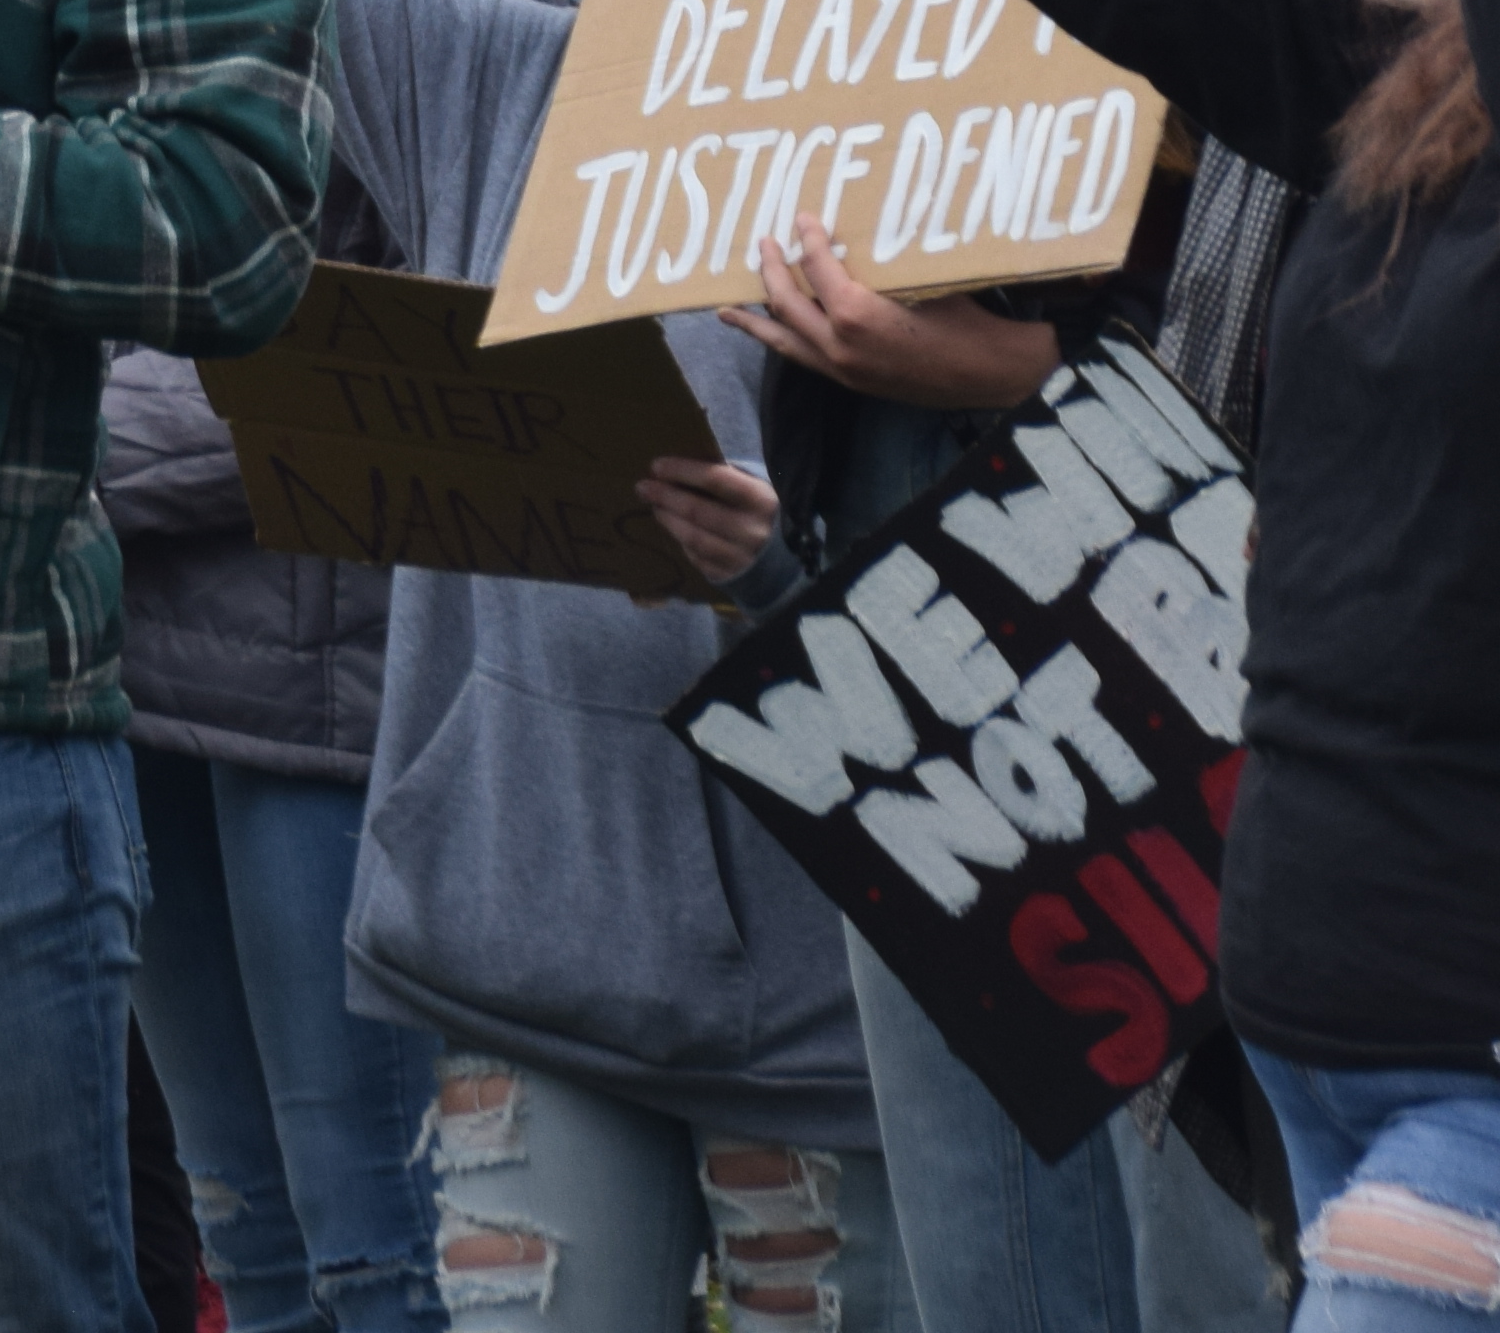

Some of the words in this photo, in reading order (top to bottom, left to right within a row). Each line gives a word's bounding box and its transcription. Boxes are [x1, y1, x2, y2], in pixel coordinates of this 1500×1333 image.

[535, 124, 884, 313] JUSTICE
[872, 88, 1135, 263] DENIED
[280, 284, 470, 372] AY
[313, 365, 598, 461] THEIR
[269, 453, 686, 593] NAMES
[688, 543, 1020, 817] WE
[853, 641, 1157, 918] NOT
